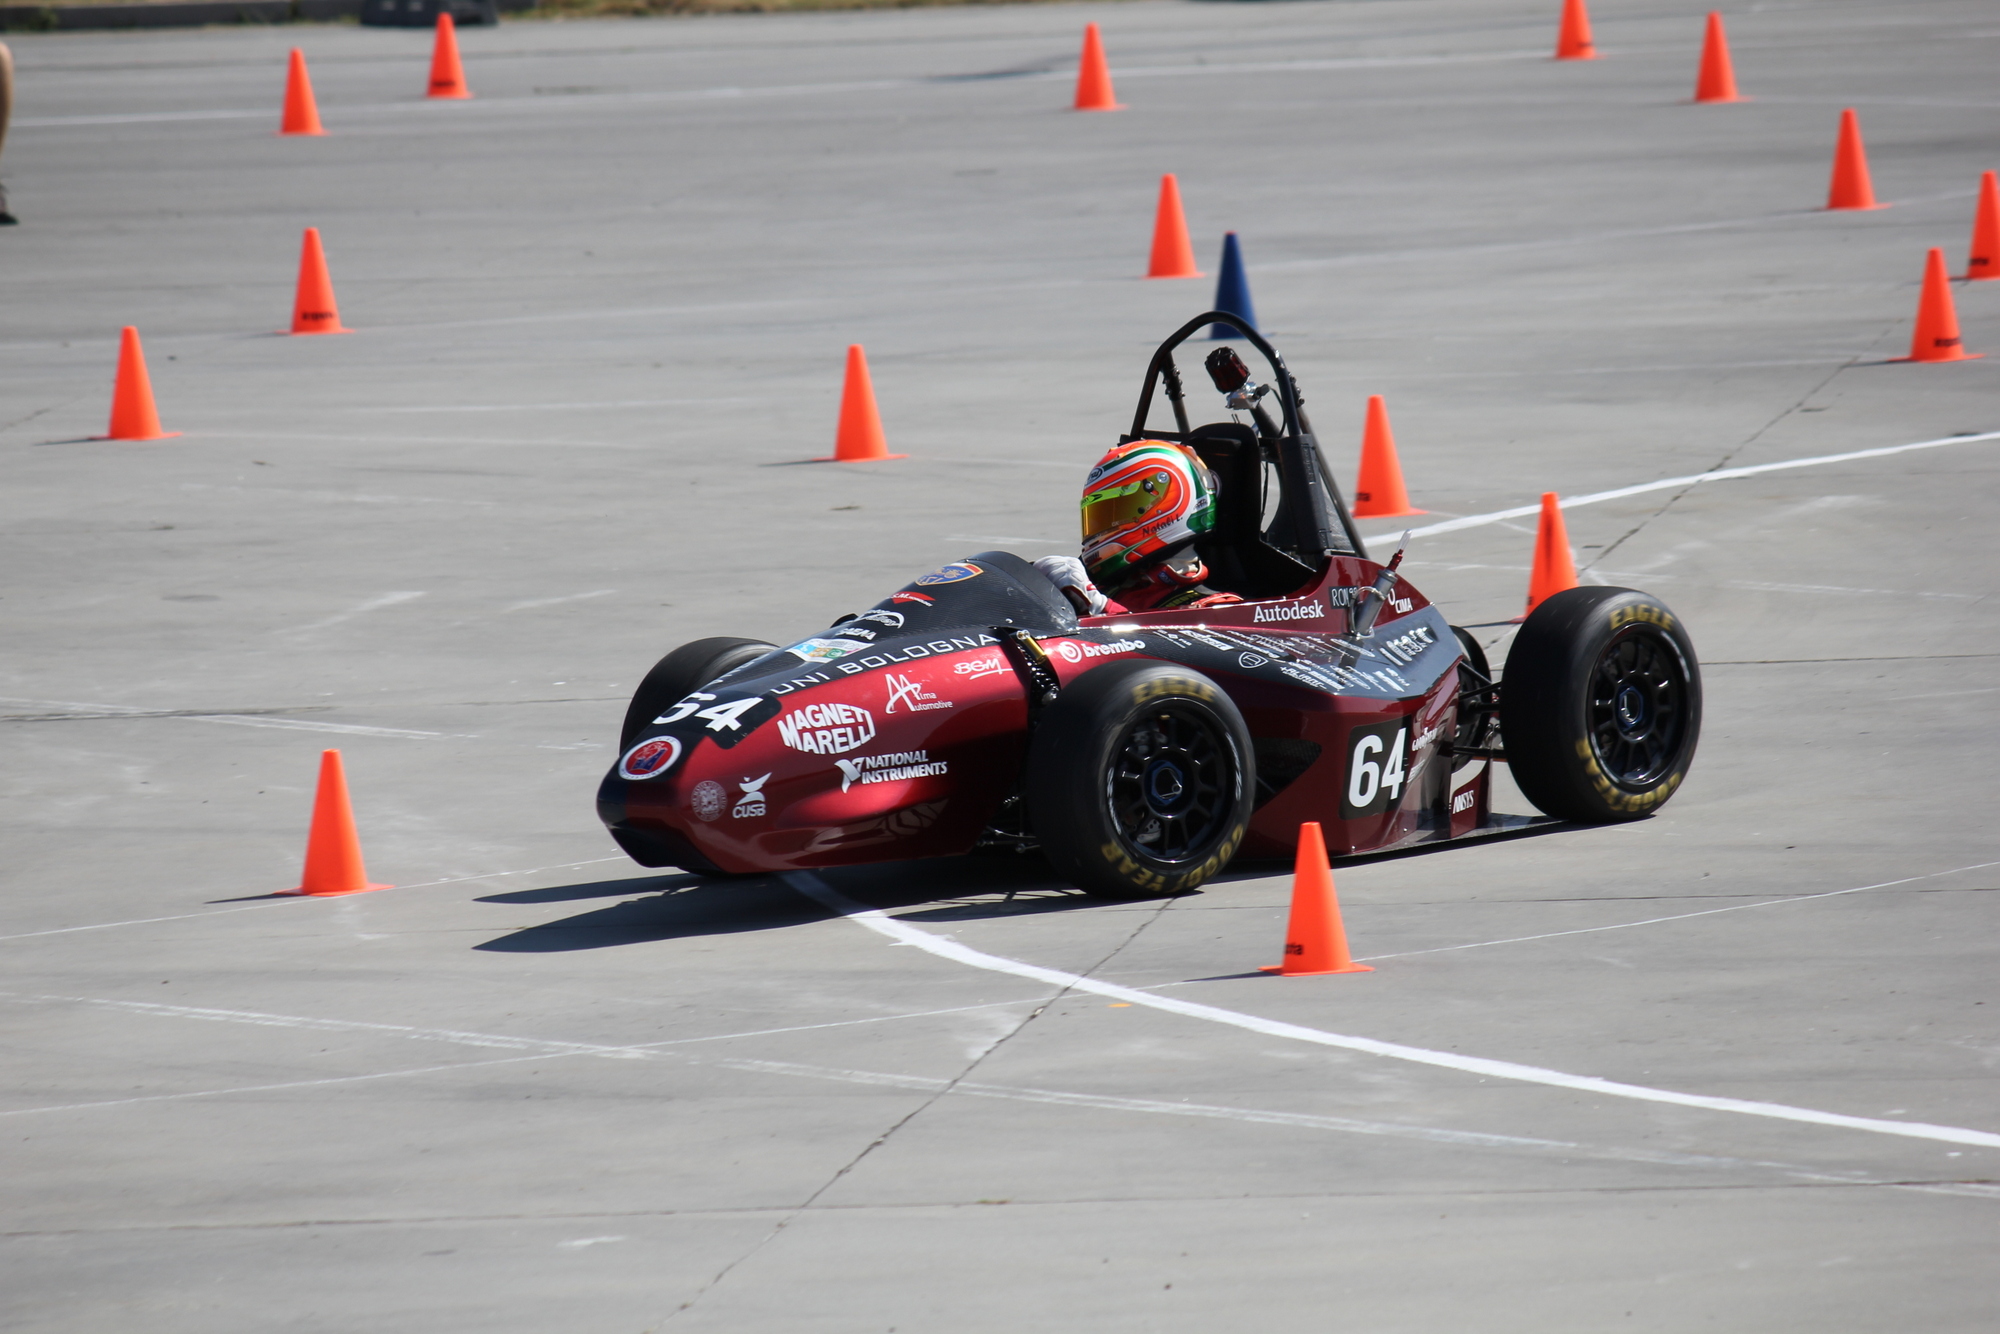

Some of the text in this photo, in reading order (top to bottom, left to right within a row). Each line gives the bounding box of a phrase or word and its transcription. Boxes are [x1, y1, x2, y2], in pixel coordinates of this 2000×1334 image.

[1253, 600, 1325, 623] Autodesk
[1608, 604, 1678, 632] EAGLE
[1084, 638, 1146, 658] brembo
[770, 671, 831, 695] UNI
[836, 633, 1001, 675] BOLOGNA
[953, 658, 1009, 678] BGM
[652, 691, 764, 733] 64
[777, 703, 876, 744] MAGNETI
[865, 750, 929, 769] NATIONAL
[1348, 727, 1407, 808] 64
[861, 762, 948, 785] INSTRUMENTS
[732, 803, 766, 819] CUSB
